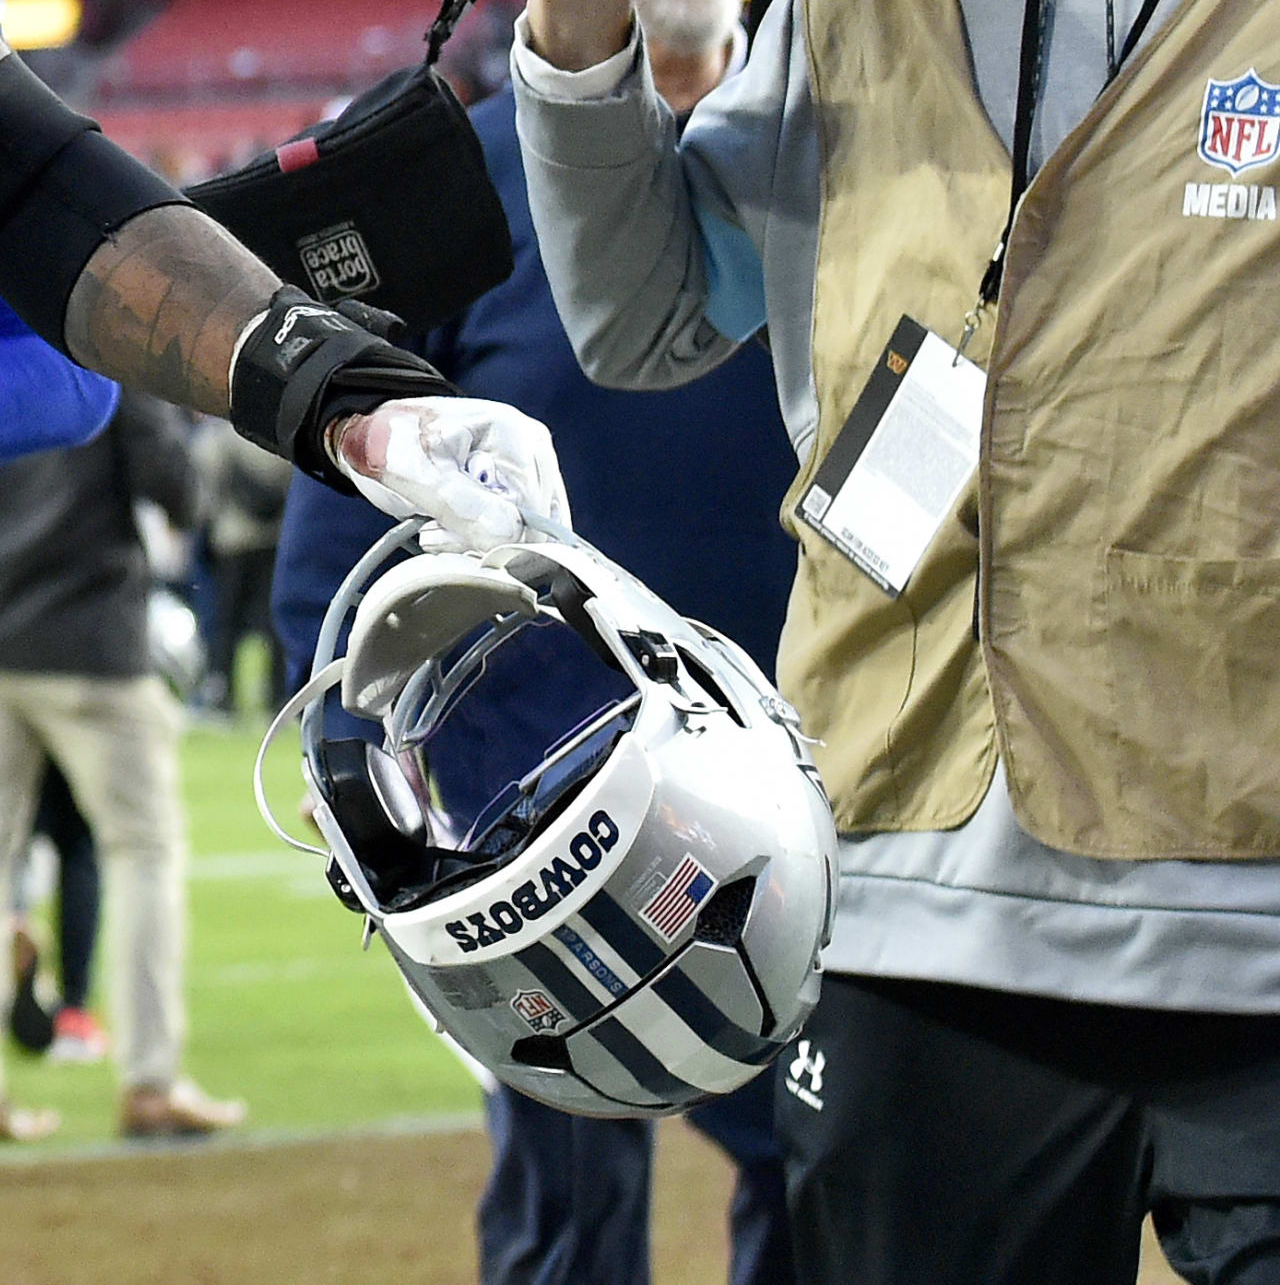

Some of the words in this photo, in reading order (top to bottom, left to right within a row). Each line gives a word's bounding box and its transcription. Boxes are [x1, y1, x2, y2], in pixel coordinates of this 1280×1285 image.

[1207, 115, 1272, 162] NFL
[1182, 181, 1277, 221] MEDIA
[305, 233, 366, 268] brace
[313, 253, 370, 292] porta
[444, 809, 620, 953] COWBOYS
[516, 994, 552, 1018] NFL
